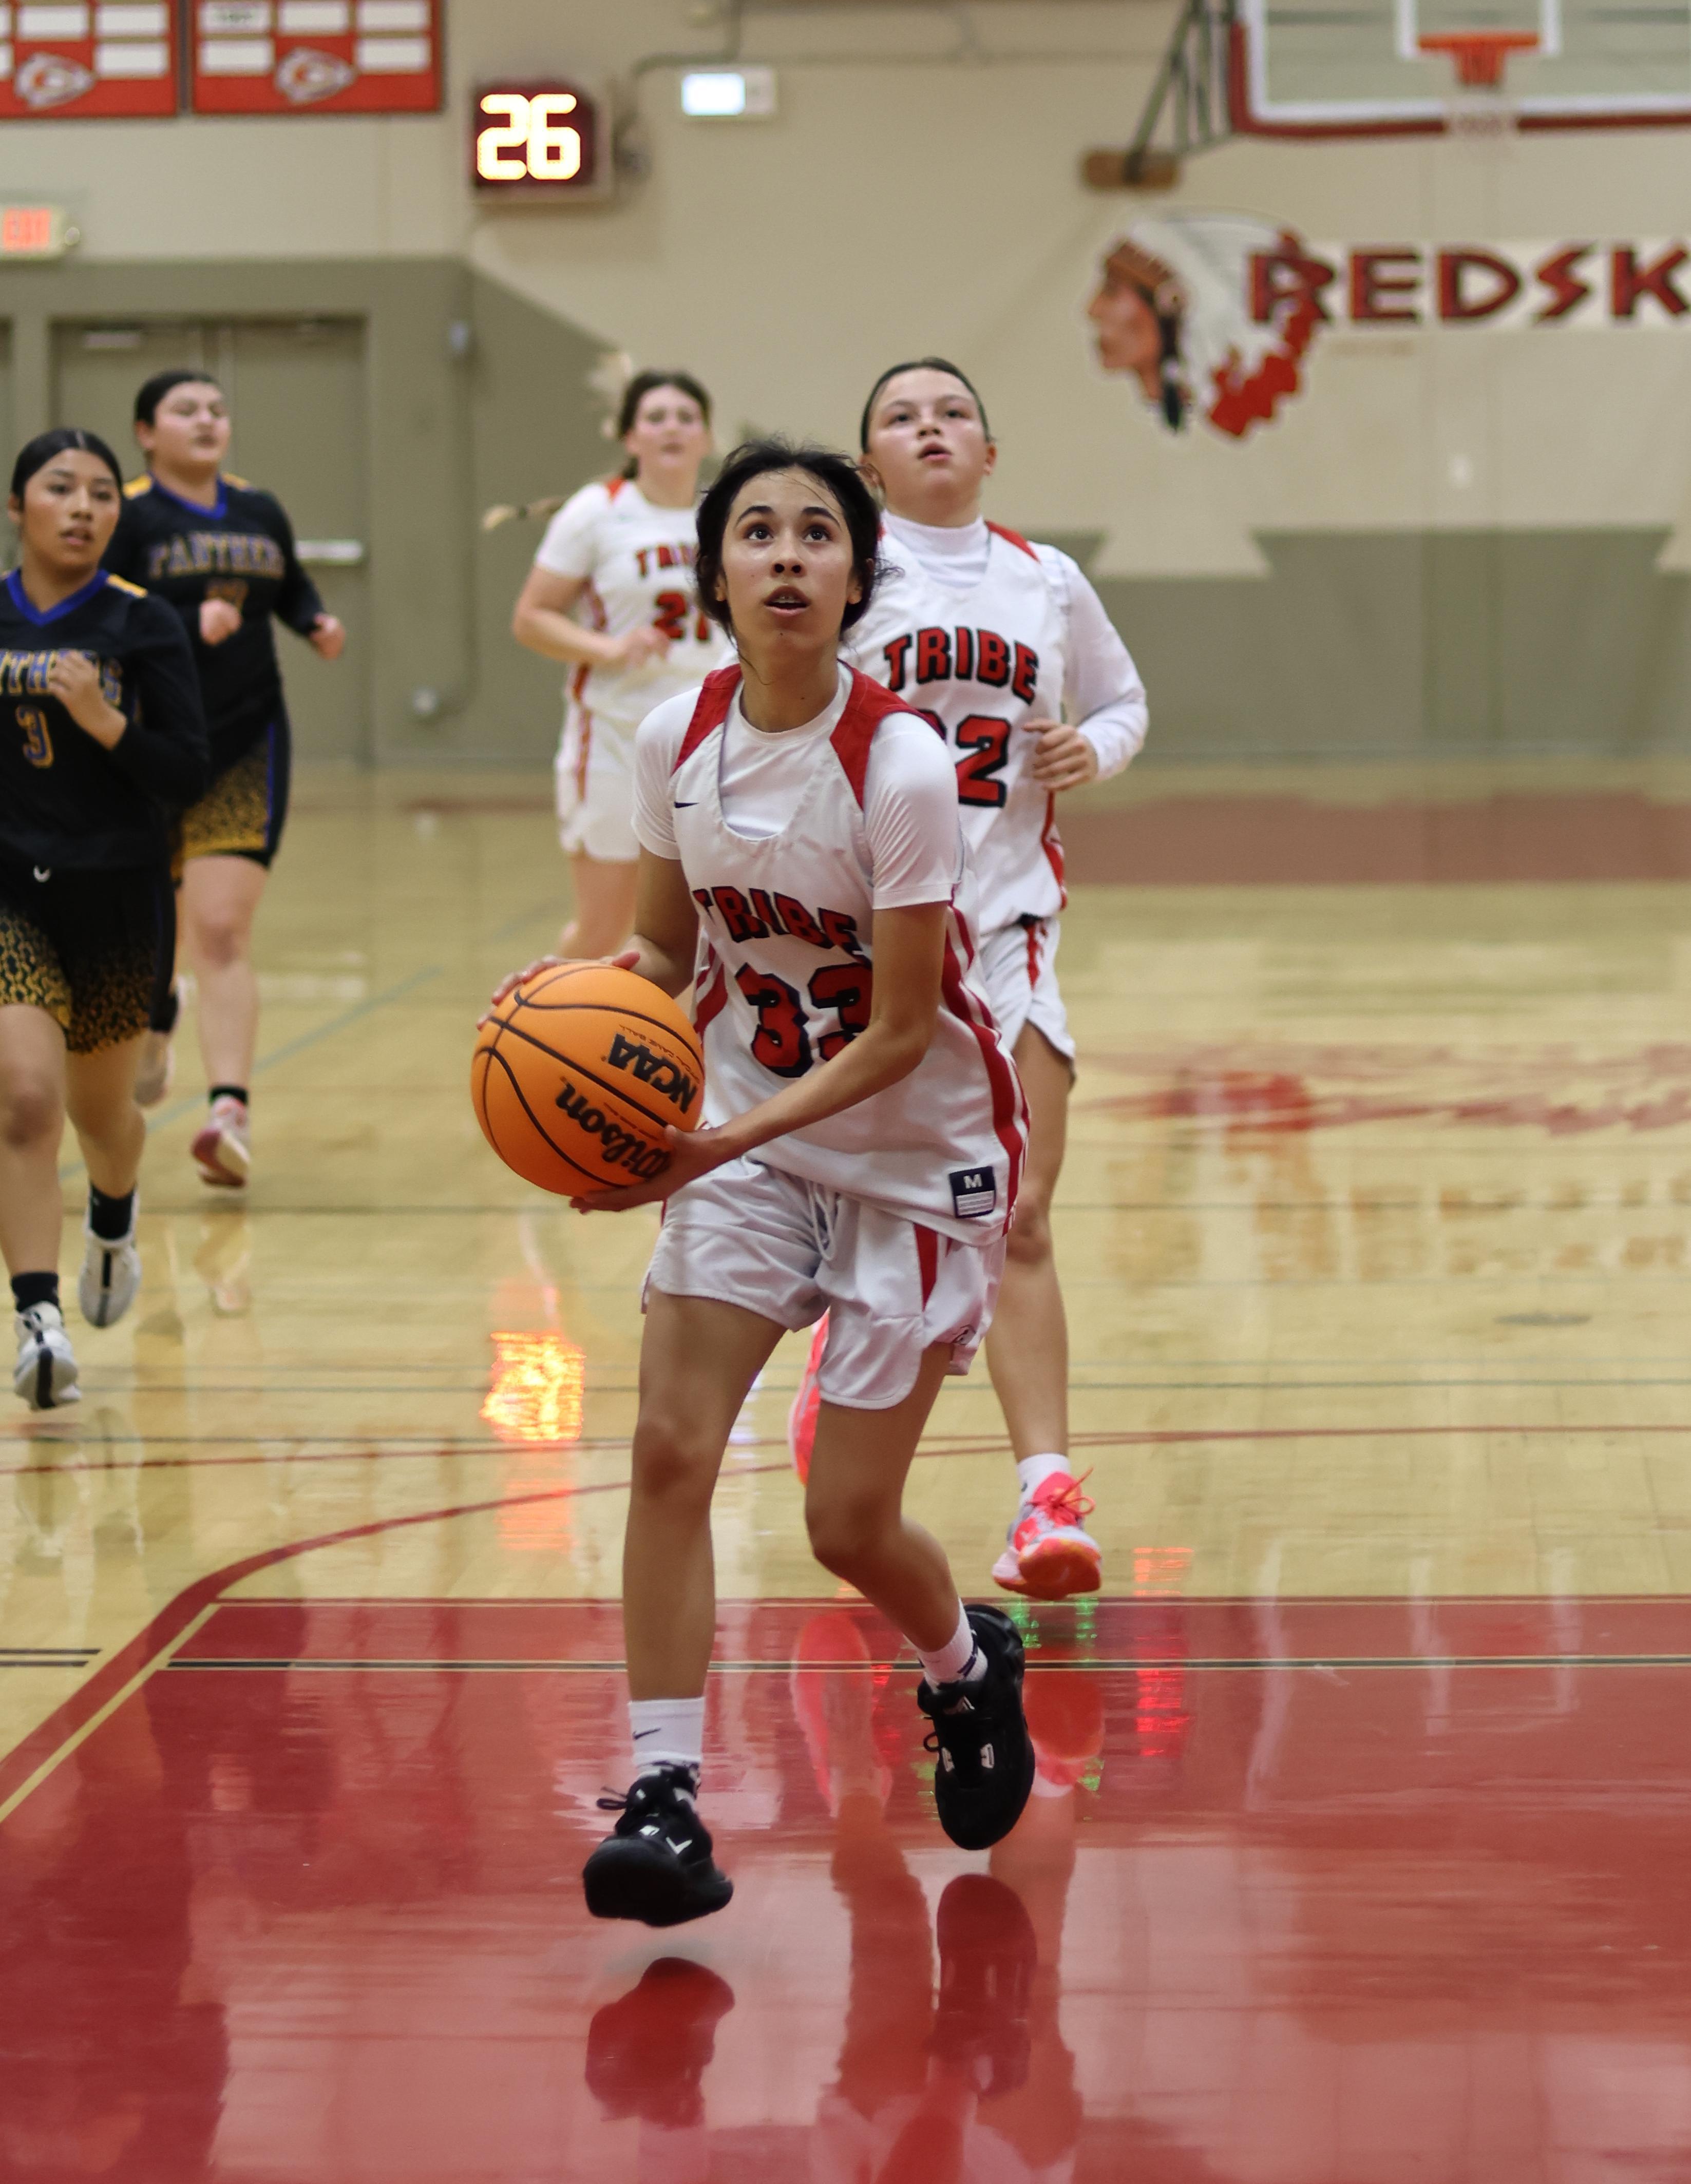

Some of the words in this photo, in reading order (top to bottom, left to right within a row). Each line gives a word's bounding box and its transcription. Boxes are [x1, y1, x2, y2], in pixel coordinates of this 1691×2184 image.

[477, 93, 581, 180] 26
[883, 626, 1039, 705] TRIBE
[15, 705, 54, 769] 3
[734, 962, 872, 1078] 33
[608, 1033, 697, 1114] NCAA
[555, 1081, 671, 1181] Wilson
[963, 1174, 982, 1189] M
